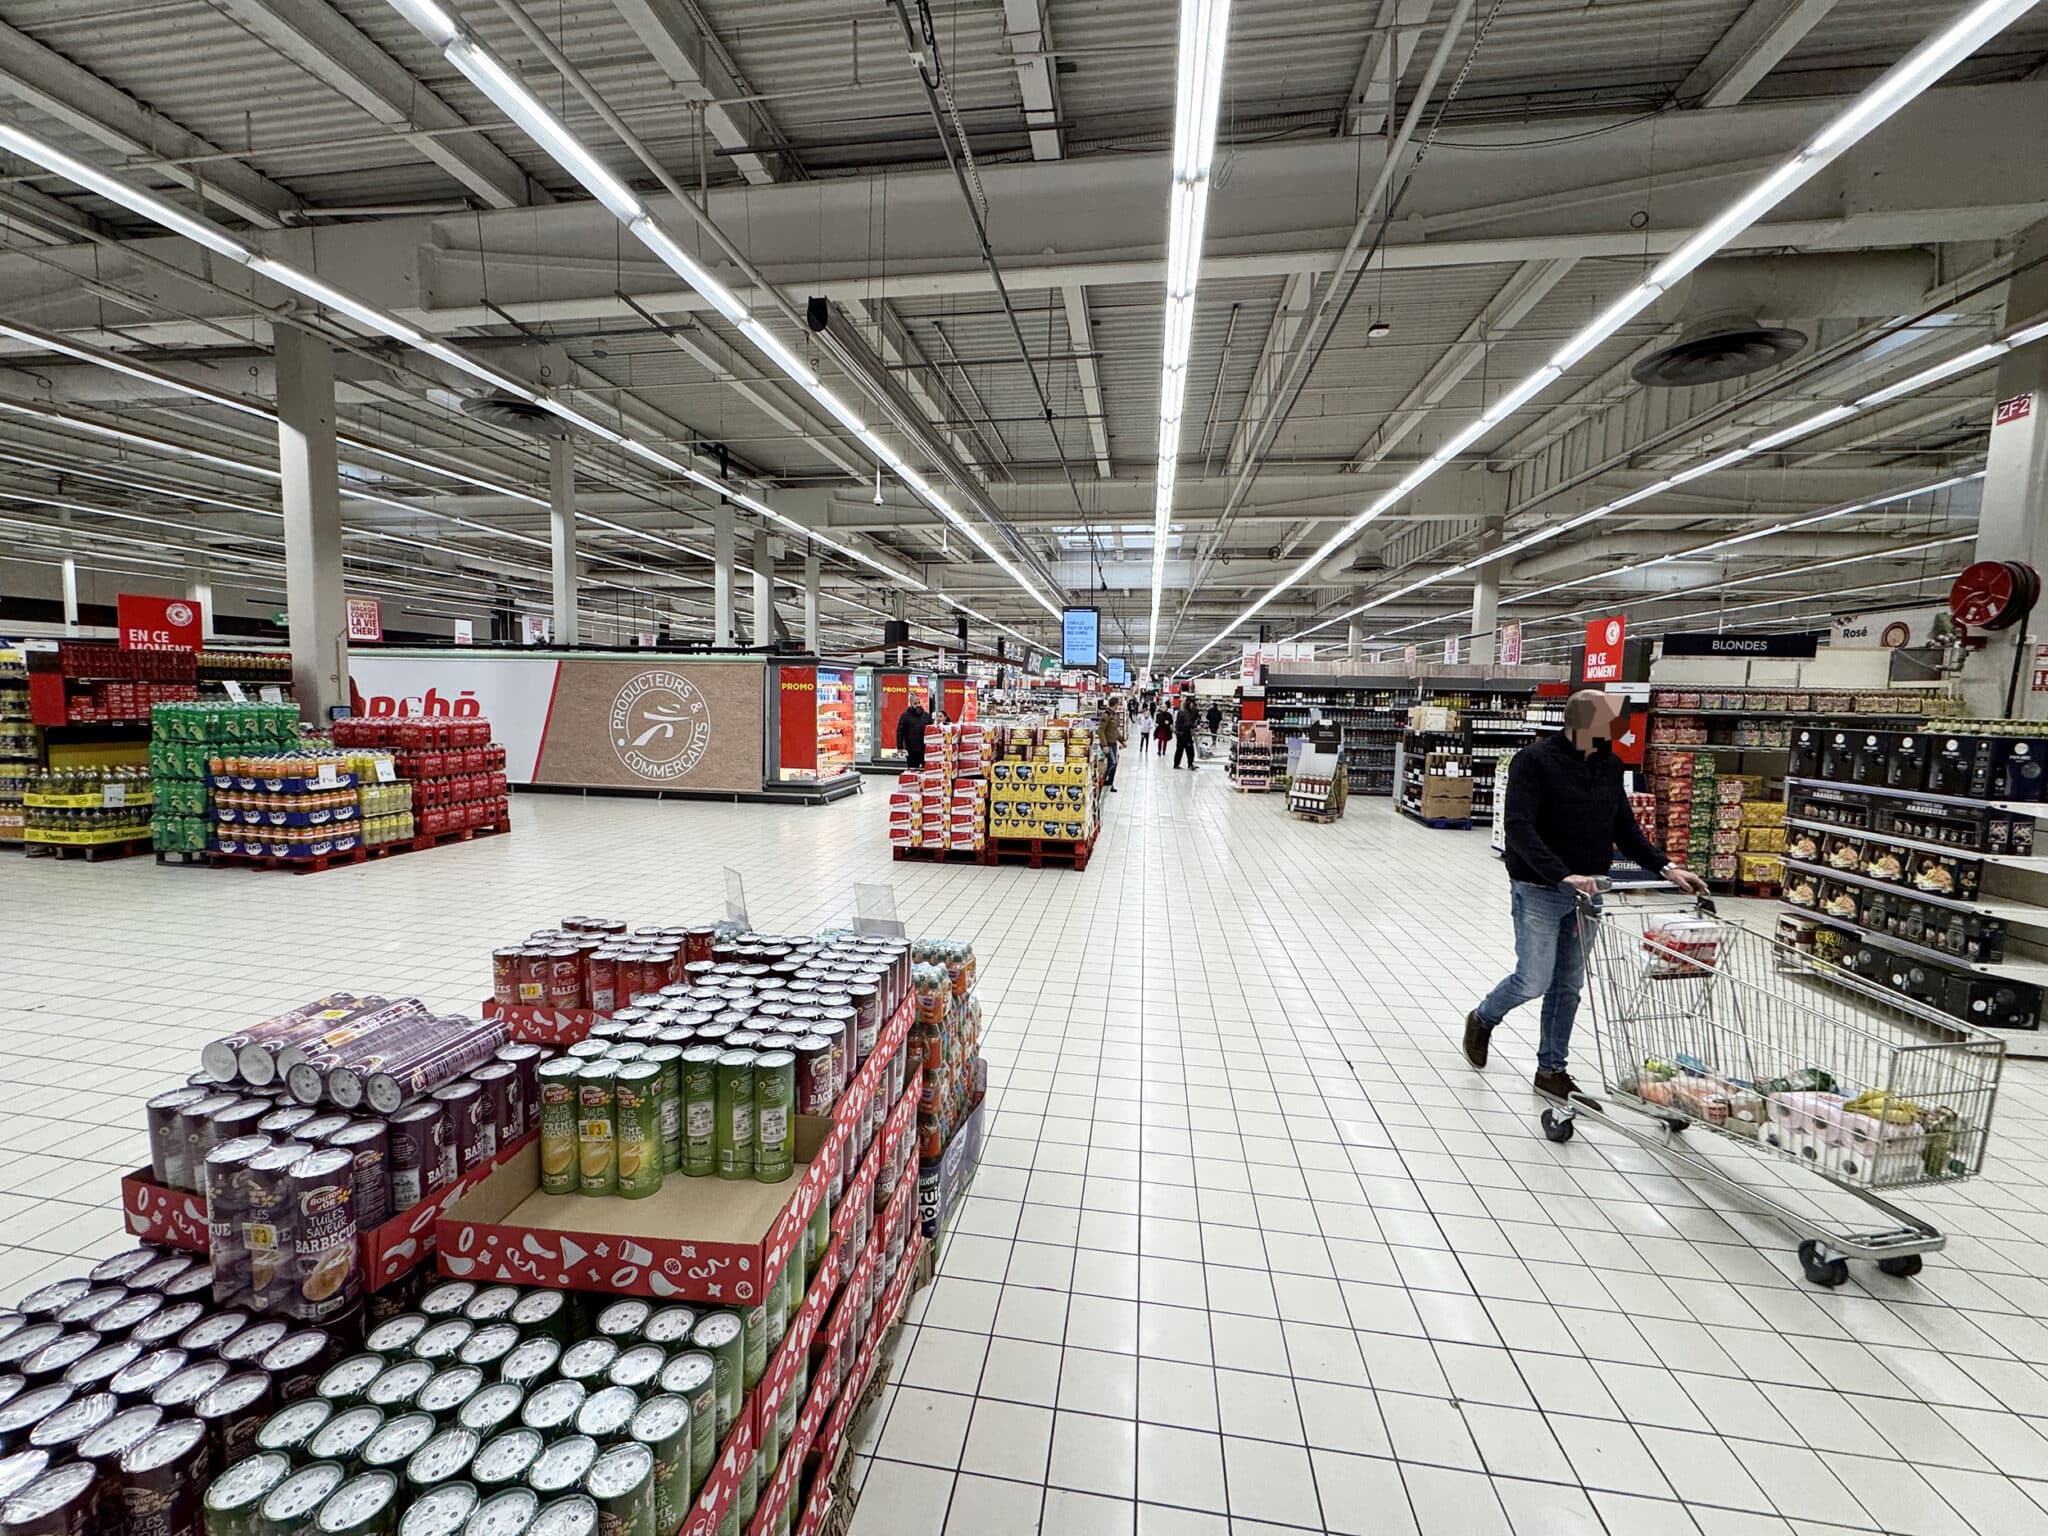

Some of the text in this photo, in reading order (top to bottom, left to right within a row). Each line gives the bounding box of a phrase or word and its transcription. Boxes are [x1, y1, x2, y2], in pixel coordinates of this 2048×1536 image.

[1998, 398, 2030, 421] ZF2
[364, 619, 377, 628] VIE
[129, 629, 169, 643] EN CE
[1843, 626, 1868, 639] Rosé
[1712, 640, 1768, 651] BLONDES
[1588, 652, 1607, 665] EN CE
[1586, 665, 1617, 679] MOMENT
[781, 682, 814, 691] PROMO
[882, 686, 907, 694] PROMO
[613, 673, 703, 729] PRODUCTEURS &
[311, 1188, 343, 1206] BOUTON
[306, 1220, 350, 1239] SAVEUR
[295, 1220, 357, 1254] BARBECU
